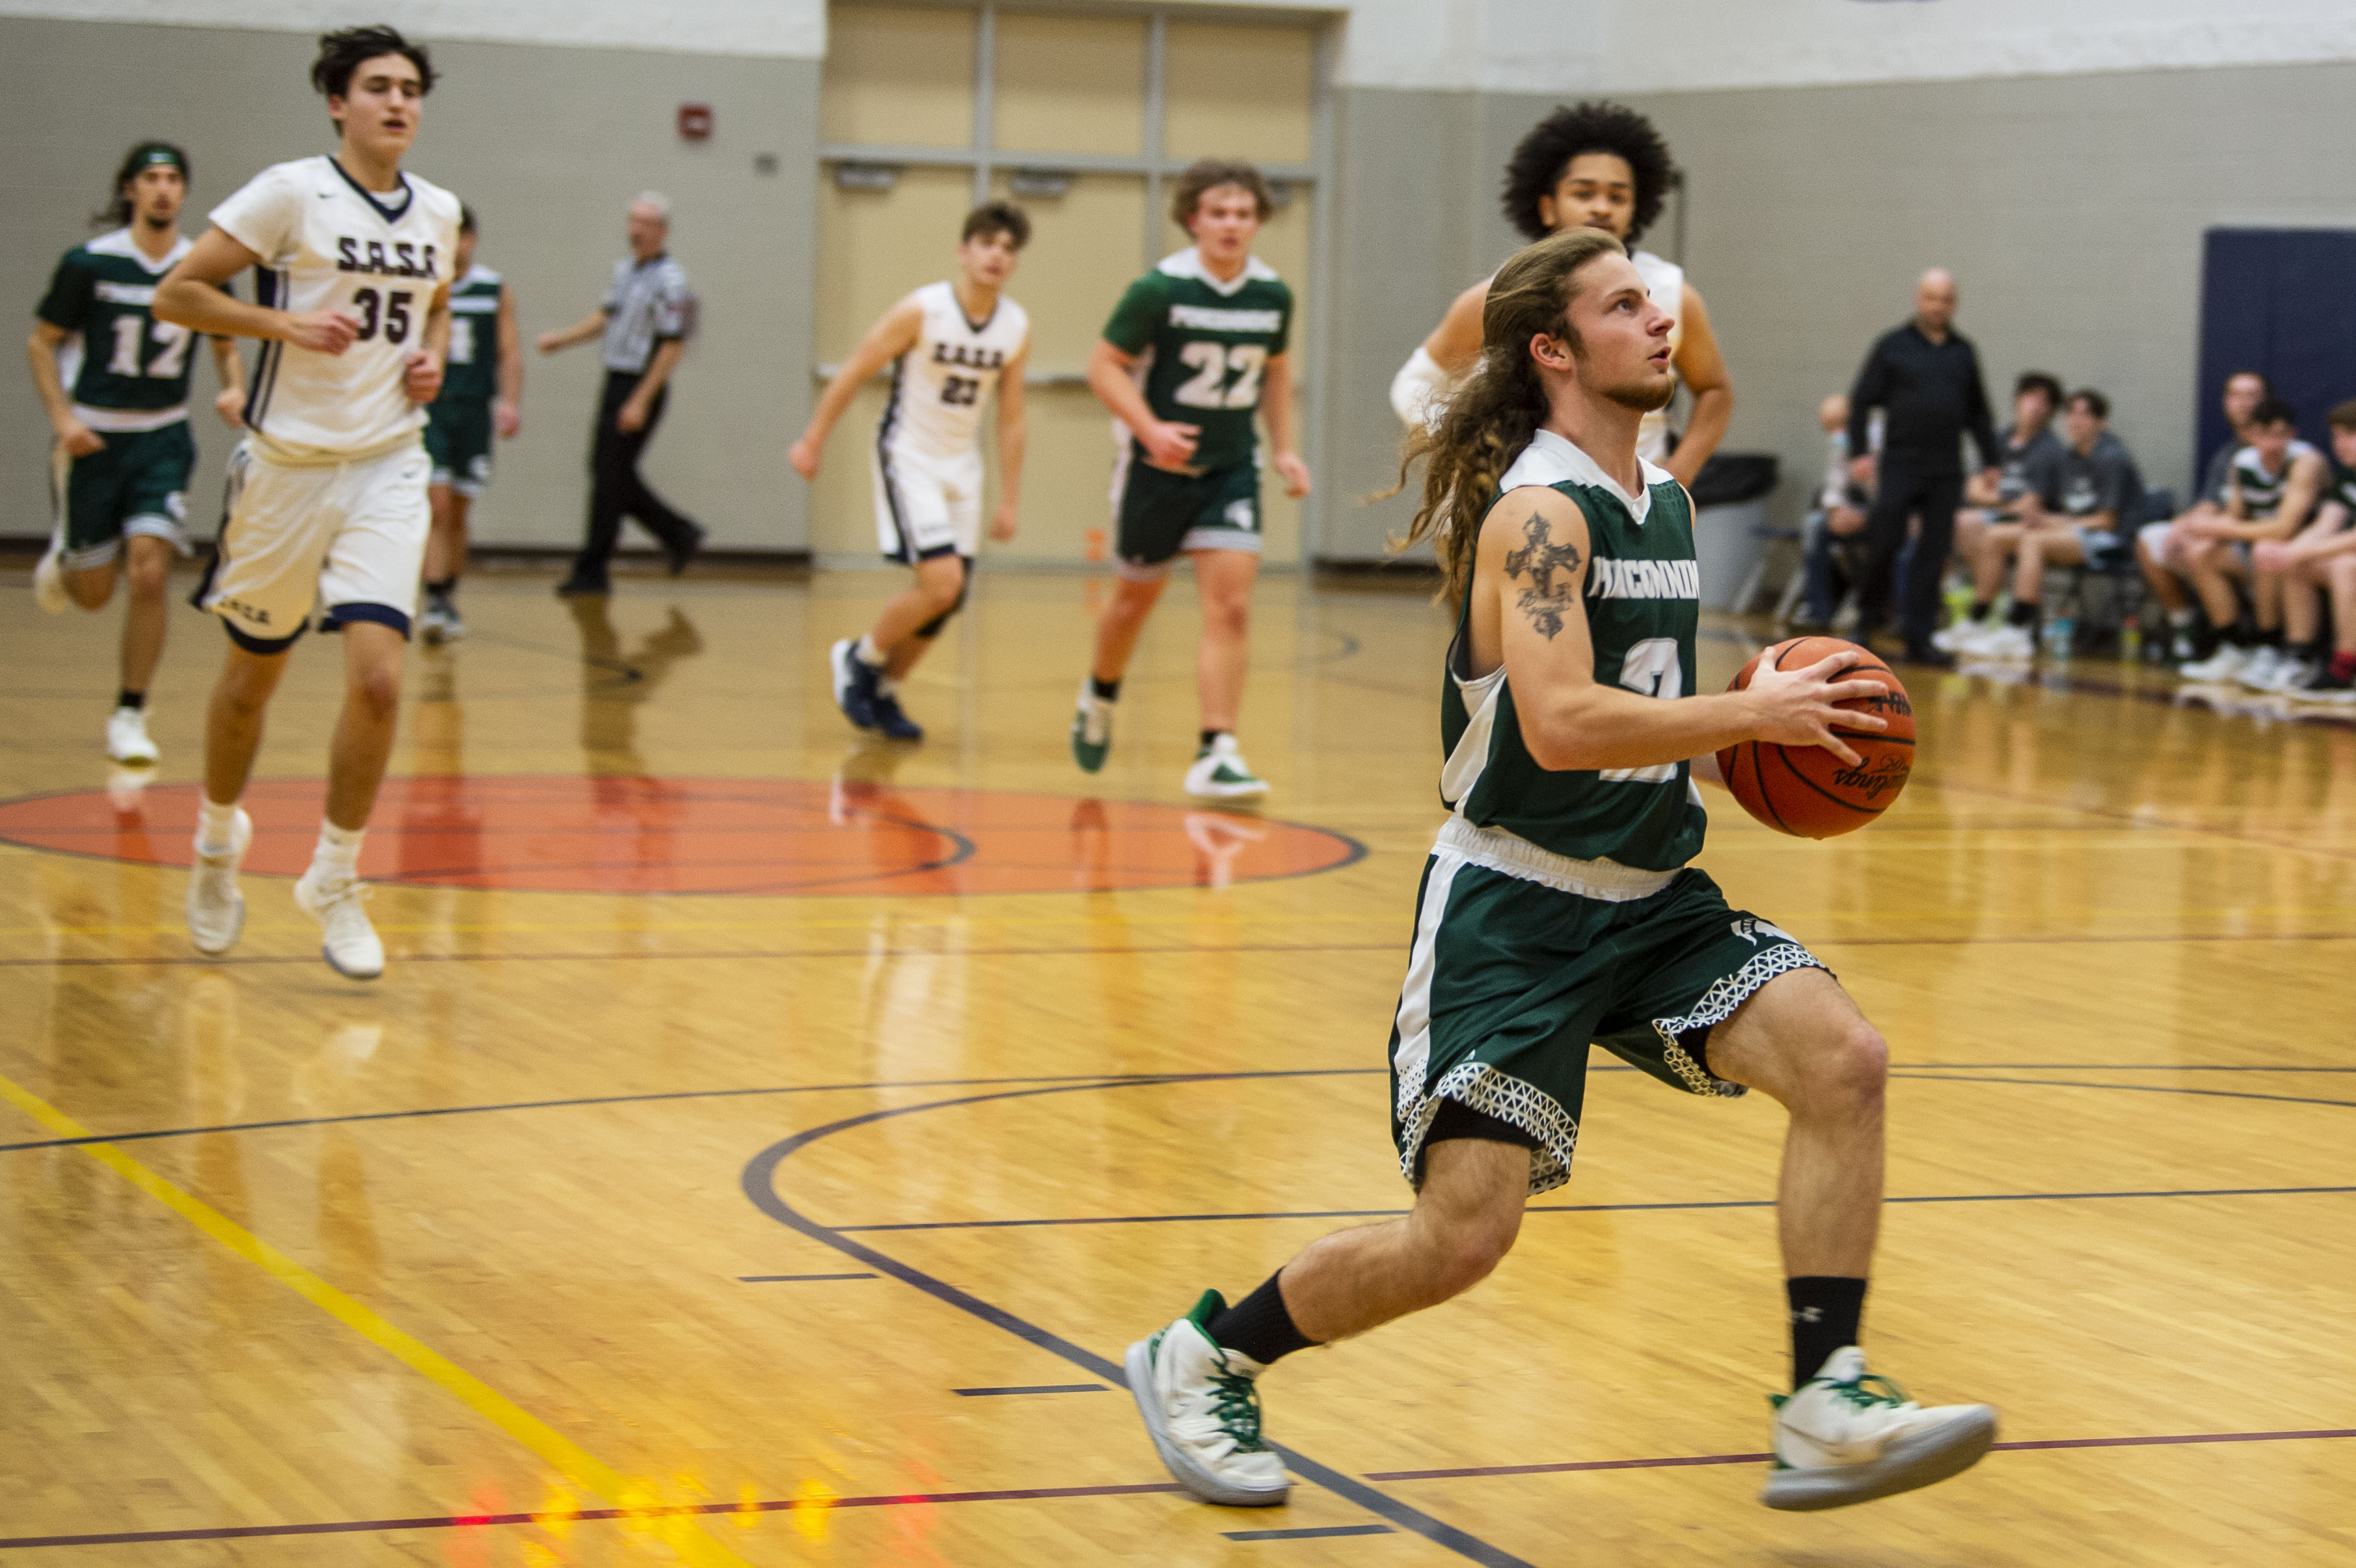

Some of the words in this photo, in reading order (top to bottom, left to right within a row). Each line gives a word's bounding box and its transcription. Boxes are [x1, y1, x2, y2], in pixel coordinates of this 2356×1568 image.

[106, 315, 190, 378] 12
[354, 286, 414, 344] 35
[1173, 340, 1267, 410] 22
